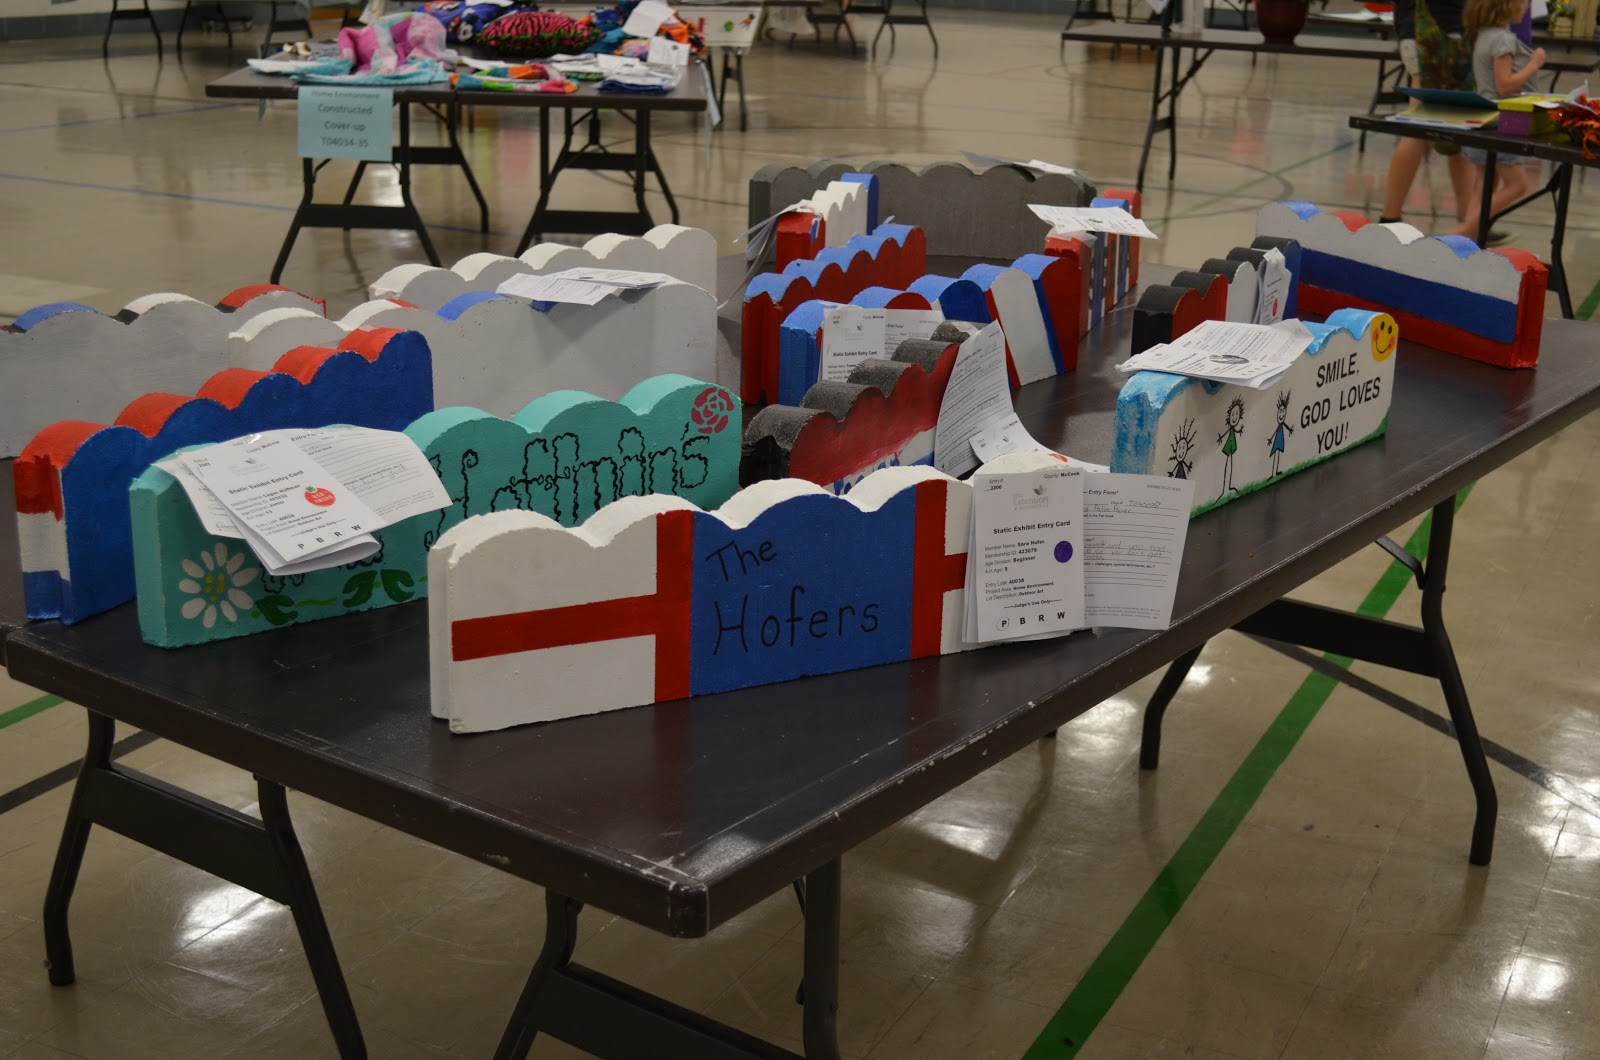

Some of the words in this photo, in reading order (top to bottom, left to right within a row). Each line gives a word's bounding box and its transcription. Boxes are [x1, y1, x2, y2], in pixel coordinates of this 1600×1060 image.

[318, 104, 373, 114] Constructed
[324, 121, 366, 132] Cover-up
[1316, 352, 1359, 388] SMILE,
[1300, 398, 1330, 430] GOD
[1339, 378, 1380, 412] LOVES
[1317, 422, 1349, 454] YOU!
[229, 486, 248, 494] Static
[249, 481, 271, 491] Exhibit
[271, 476, 288, 485] Entry
[1014, 497, 1048, 506] Extension
[705, 540, 777, 582] The
[713, 584, 879, 656] Hofers
